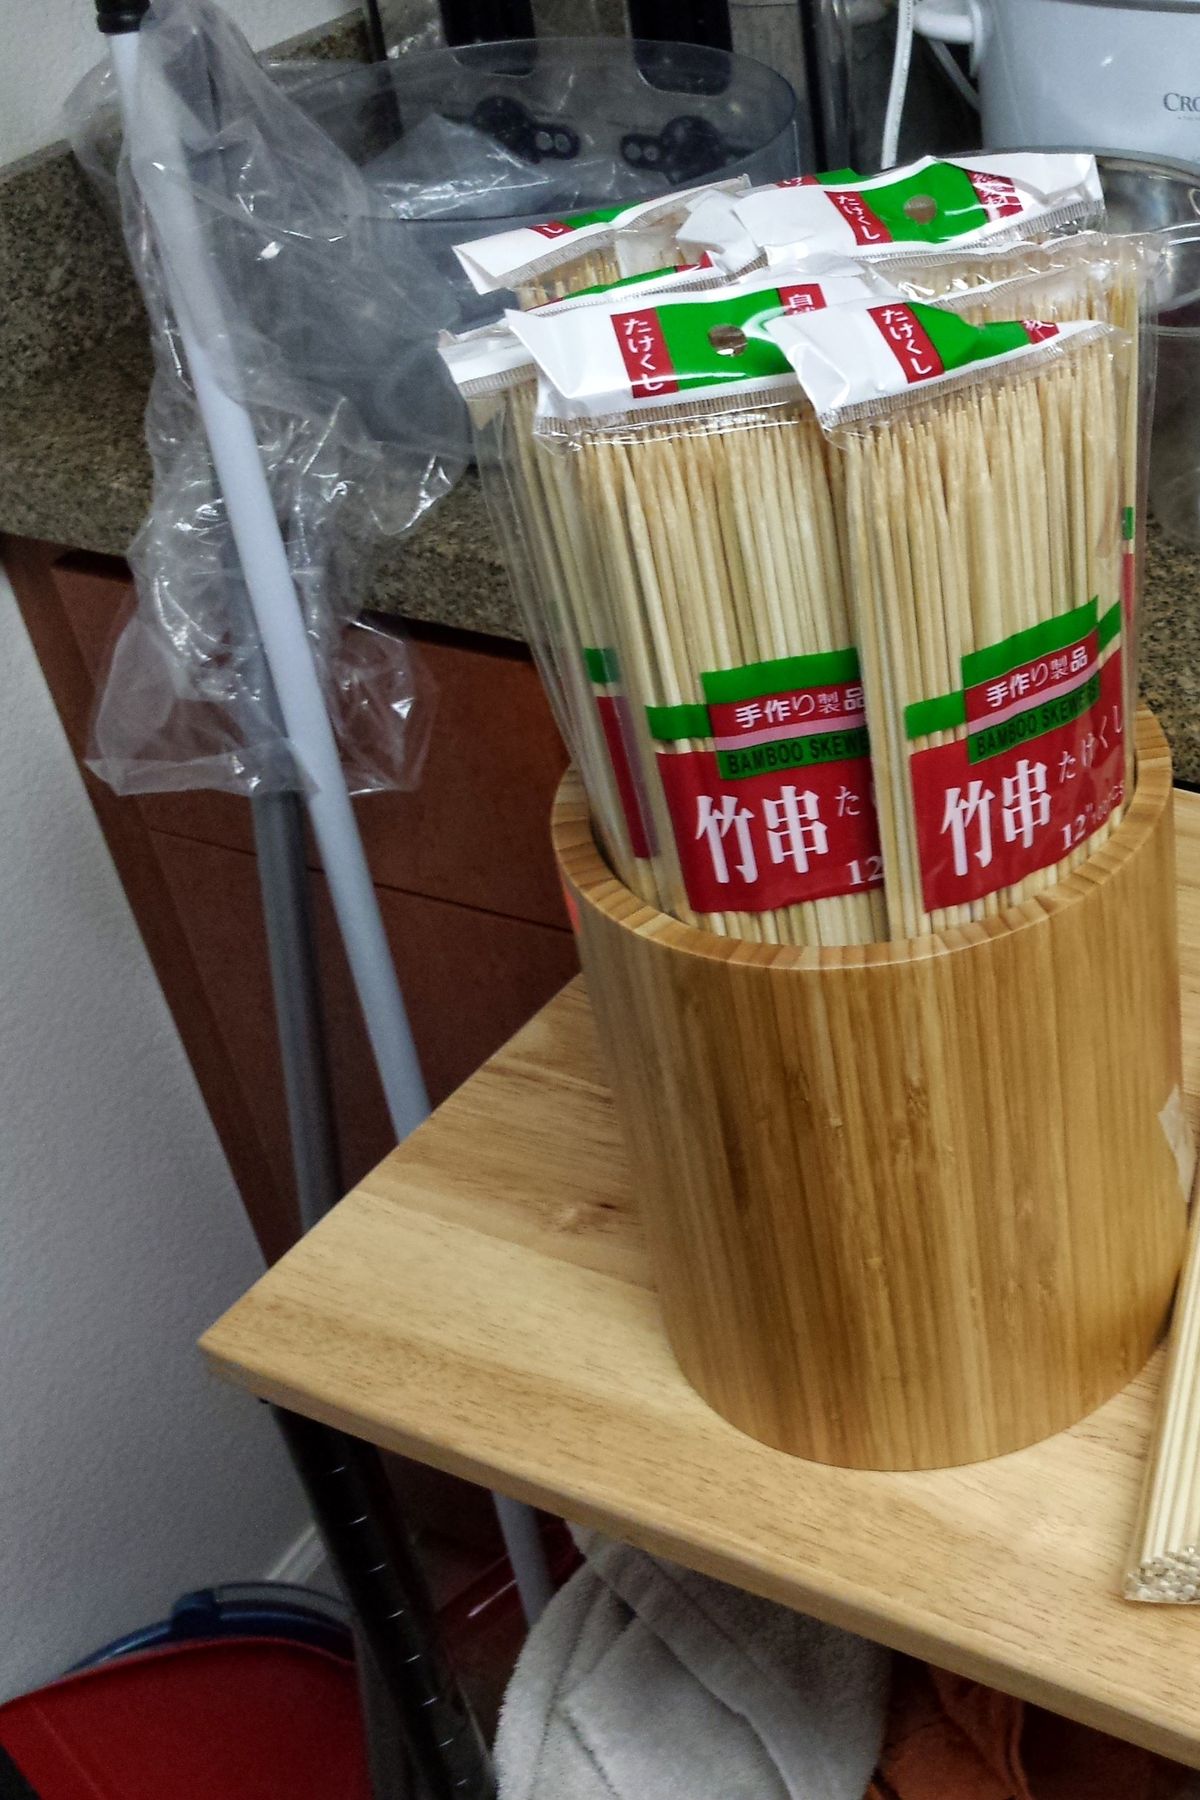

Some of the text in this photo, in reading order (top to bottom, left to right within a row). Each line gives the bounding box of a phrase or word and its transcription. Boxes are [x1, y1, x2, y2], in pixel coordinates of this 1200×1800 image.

[623, 317, 664, 391] たけくし
[881, 309, 933, 375] たけくし
[735, 687, 865, 729] 手作り製品
[986, 645, 1089, 708] 手作り製品
[727, 740, 803, 775] BAMBOO
[978, 714, 1037, 757] BAMBOO
[694, 785, 829, 884] 竹串
[940, 758, 1052, 877] 竹串
[846, 855, 883, 886] 12
